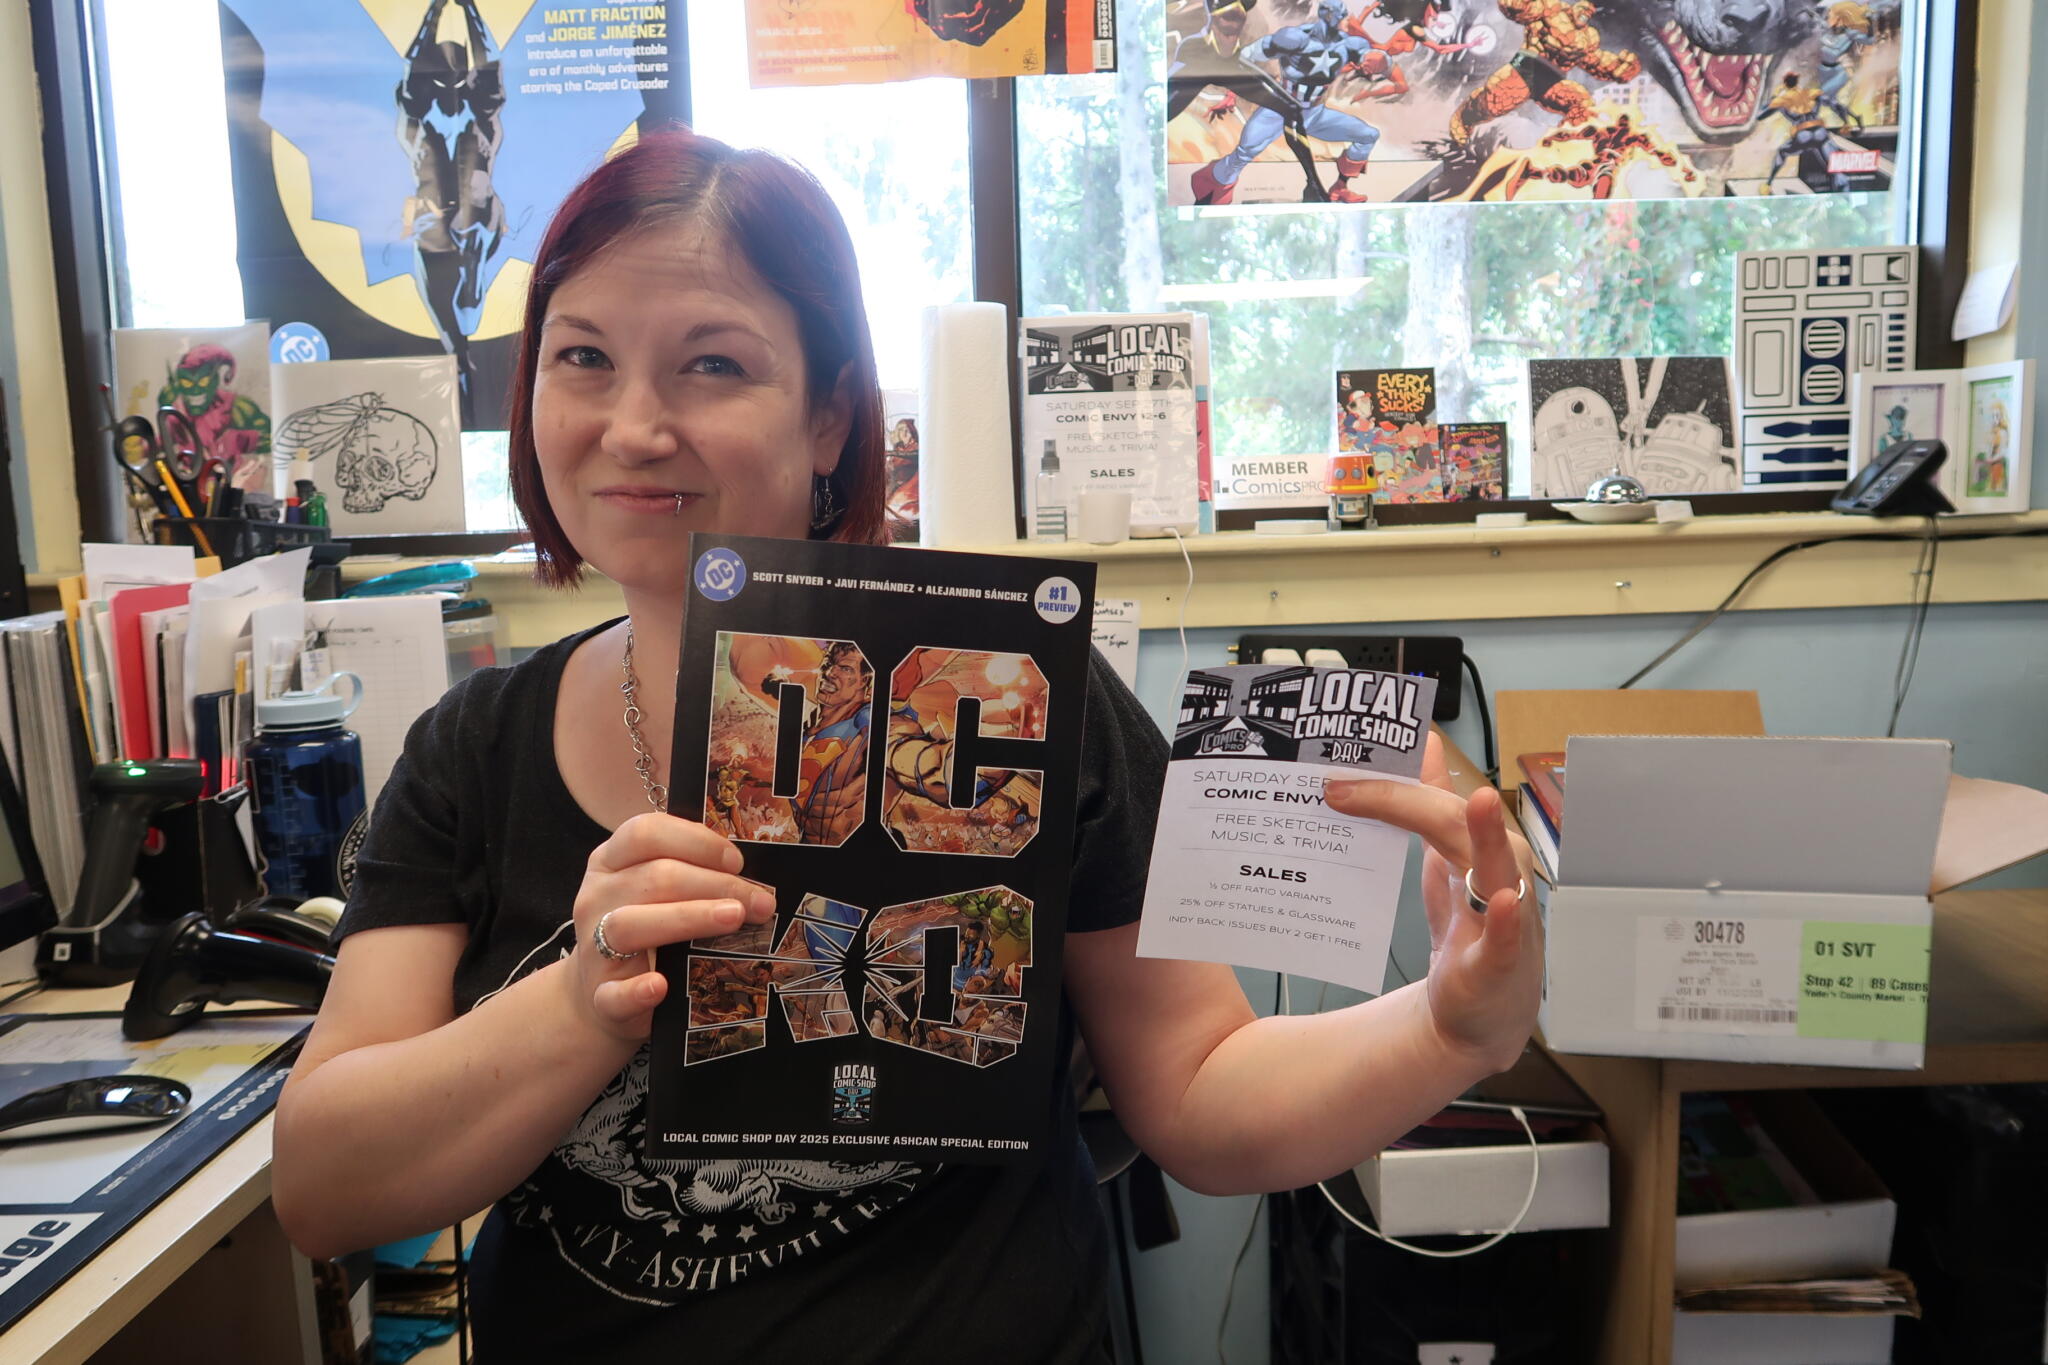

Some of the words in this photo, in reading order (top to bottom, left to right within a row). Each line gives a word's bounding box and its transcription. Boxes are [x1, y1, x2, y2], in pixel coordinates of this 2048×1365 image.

[545, 10, 587, 24] MATT
[591, 6, 666, 22] FRACTION
[525, 32, 546, 43] and
[548, 27, 596, 42] JORGE
[601, 23, 666, 40] JIMÉNEZ
[528, 49, 577, 60] introduce
[580, 48, 593, 57] an
[596, 43, 668, 58] unforgettable
[529, 67, 547, 76] era
[550, 65, 560, 75] of
[564, 63, 606, 75] monthly
[608, 62, 668, 74] adventures
[520, 83, 562, 95] starring
[565, 81, 582, 92] the
[585, 79, 617, 92] Caped
[621, 78, 669, 91] Crusader
[1831, 151, 1876, 169] MARVEL
[1106, 324, 1185, 359] LOCAL
[1106, 355, 1149, 376] COMIC
[1150, 355, 1185, 373] SHOP
[1377, 373, 1430, 390] EVERY
[1046, 400, 1111, 411] SATURDAY
[1379, 396, 1426, 412] SUCKS!
[1056, 414, 1099, 422] COMIC
[1102, 413, 1136, 422] ENVY
[1108, 445, 1117, 453] &
[1090, 468, 1136, 478] SALES
[1231, 461, 1309, 476] MEMBER
[707, 562, 733, 587] DC
[752, 571, 783, 583] SCOTT
[786, 574, 824, 586] SNYDER
[834, 578, 857, 589] JAVI
[859, 579, 915, 593] FERNÁNDEZ
[925, 584, 982, 599] ALEJANDRO
[984, 587, 1028, 602] SÁNCHEZ
[1048, 586, 1067, 601] #1
[1037, 601, 1076, 613] PREVIEW
[1297, 671, 1421, 728] LOCAL
[1203, 730, 1248, 752] COMICS
[1293, 713, 1357, 740] COMIC
[1359, 716, 1417, 752] SHOP
[702, 630, 1051, 859] DC
[1225, 743, 1245, 751] PRO
[1330, 740, 1364, 763] DAY
[1193, 770, 1291, 785] SATURDAY
[1204, 788, 1267, 800] COMIC
[1273, 791, 1325, 806] ENVY
[1216, 813, 1257, 826] FREE
[1263, 816, 1354, 839] SKETCHES,
[1211, 830, 1268, 845] MUSIC,
[1274, 834, 1285, 845] &
[1292, 837, 1349, 855] TRIVIA!
[1240, 865, 1307, 883] SALES
[1221, 883, 1242, 891] OFF
[1245, 885, 1276, 896] RATIO
[1279, 890, 1332, 905] VARIANTS
[1180, 898, 1200, 906] 25%
[1204, 900, 1225, 908] OFF
[1228, 902, 1274, 914] STATUES
[1277, 908, 1285, 916] &
[1288, 910, 1356, 929] GLASSWARE
[1168, 915, 1194, 924] INDY
[1197, 917, 1225, 927] BACK
[1229, 921, 1266, 932] ISSUES
[1269, 925, 1292, 935] BUY
[1304, 931, 1325, 942] GET
[1334, 938, 1361, 950] FREE
[1695, 921, 1745, 944] 30478
[1815, 941, 1834, 956] 01
[1842, 941, 1876, 958] SVT
[1805, 974, 1834, 988] Stop
[1838, 976, 1854, 988] 42
[1871, 978, 1886, 990] 89
[1890, 978, 1929, 992] Cases
[1840, 991, 1872, 1001] Country
[1875, 993, 1905, 1002] Market
[834, 1064, 877, 1081] LOCAL
[833, 1079, 855, 1088] COMIC
[856, 1079, 877, 1088] SHOP
[663, 1133, 698, 1143] LOCAL
[702, 1133, 739, 1143] COMIC
[742, 1133, 772, 1143] SHOP
[775, 1134, 797, 1144] DAY
[800, 1134, 829, 1144] 2025
[832, 1135, 890, 1145] EXCLUSIVE
[893, 1136, 938, 1146] ASHCAN
[941, 1137, 984, 1149] SPECIAL
[987, 1139, 1029, 1150] EDITION
